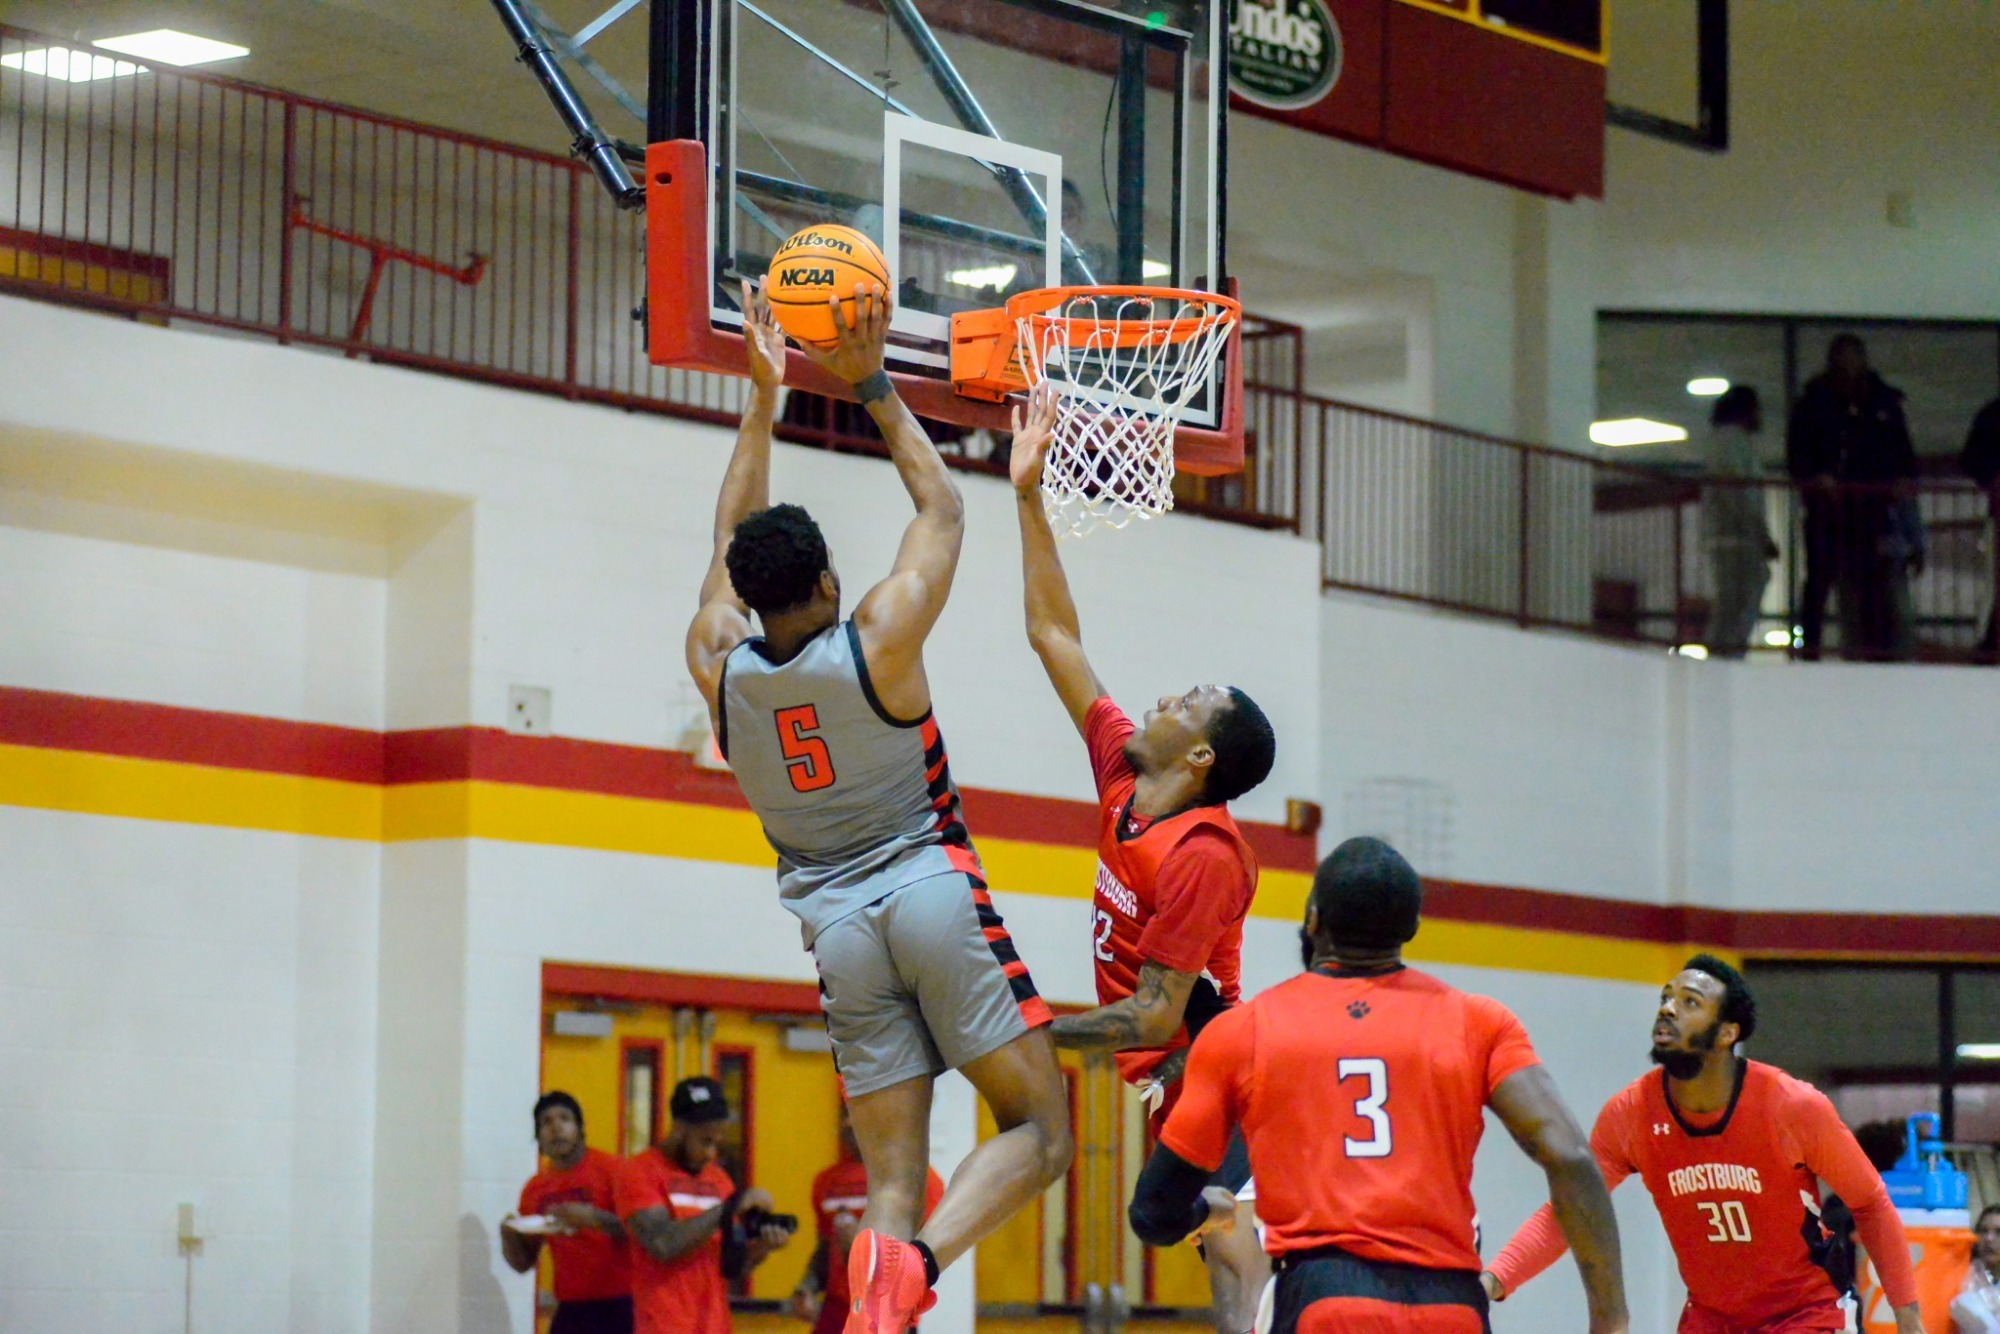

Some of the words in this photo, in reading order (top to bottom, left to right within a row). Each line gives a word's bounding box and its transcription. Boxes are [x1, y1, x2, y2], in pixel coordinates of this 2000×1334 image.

[780, 268, 835, 286] NCAA
[774, 703, 836, 793] 5
[1337, 1057, 1392, 1158] 3
[1667, 1163, 1762, 1197] FROSTBURG
[1697, 1201, 1752, 1242] 30
